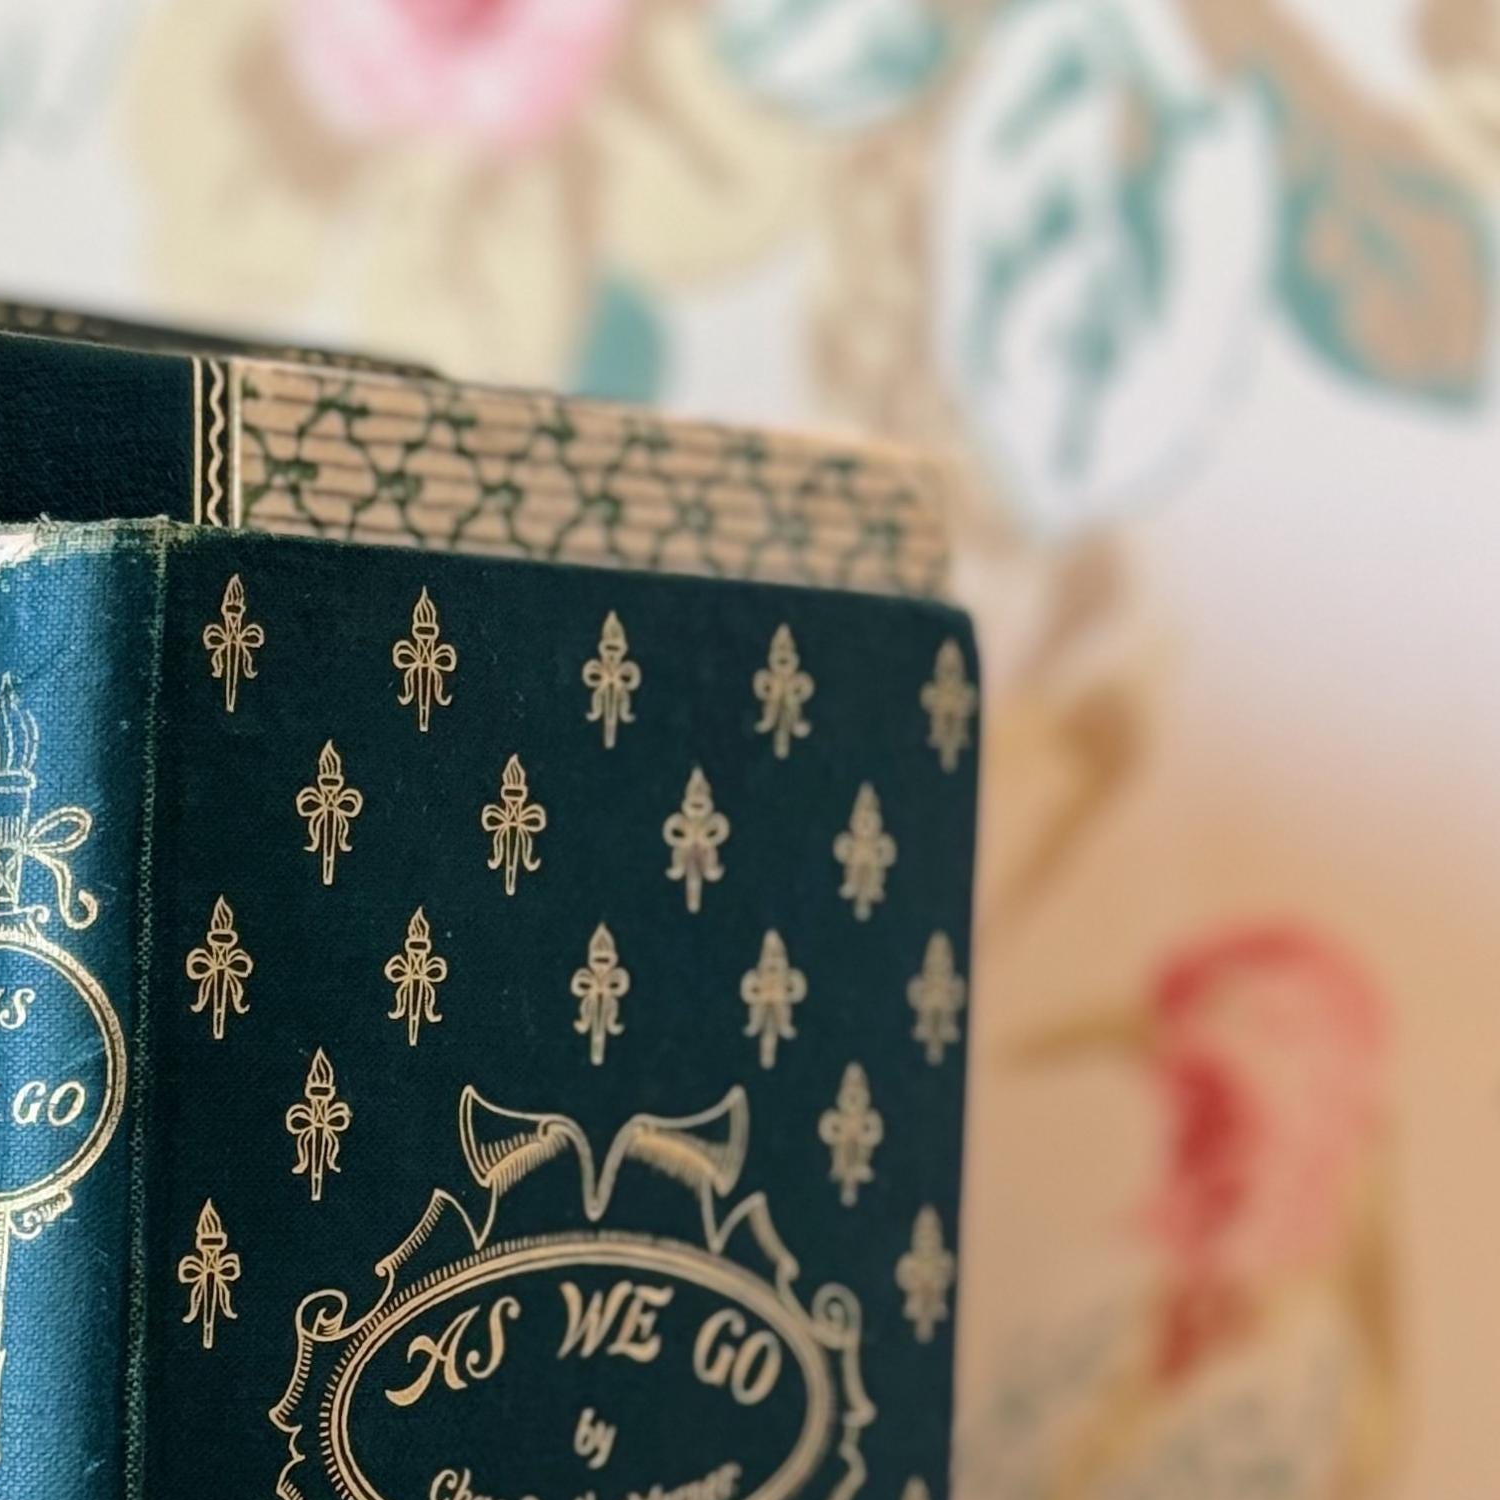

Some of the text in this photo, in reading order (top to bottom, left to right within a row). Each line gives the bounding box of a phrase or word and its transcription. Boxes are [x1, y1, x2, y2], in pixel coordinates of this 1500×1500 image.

[11, 1080, 86, 1127] GO
[384, 1280, 783, 1407] AS WE GO
[572, 1407, 618, 1469] by
